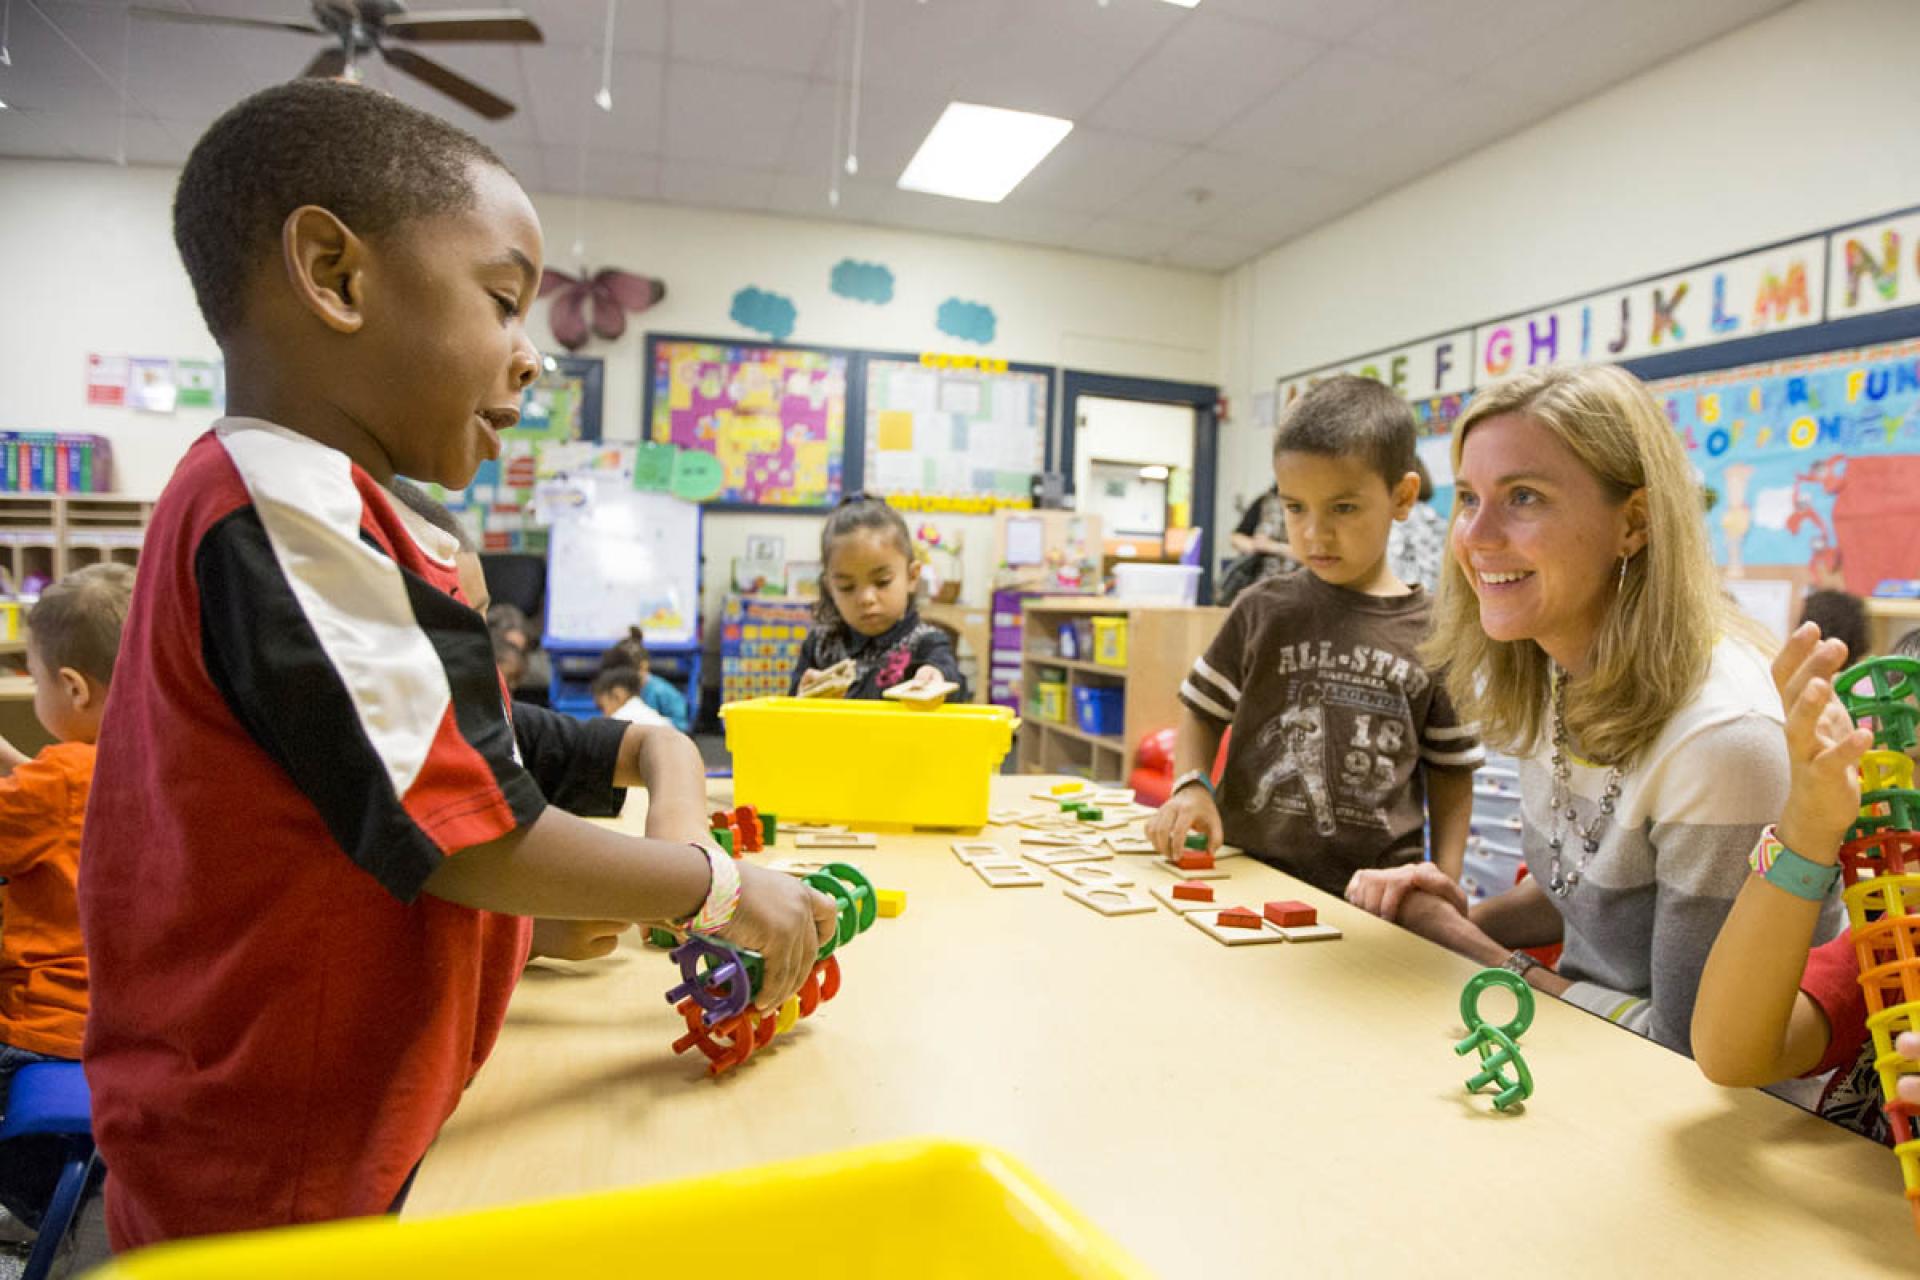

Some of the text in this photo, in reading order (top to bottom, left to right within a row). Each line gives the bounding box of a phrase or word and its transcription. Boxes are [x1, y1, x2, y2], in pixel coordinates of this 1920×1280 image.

[1435, 343, 1453, 391] F
[1485, 328, 1514, 376] G
[1527, 315, 1559, 366] H
[1580, 306, 1592, 356] I
[1607, 297, 1632, 354] J
[1650, 281, 1689, 346] K
[1711, 273, 1740, 333] L
[1753, 258, 1811, 328] M
[1845, 228, 1899, 308] N
[1351, 714, 1405, 754] 18
